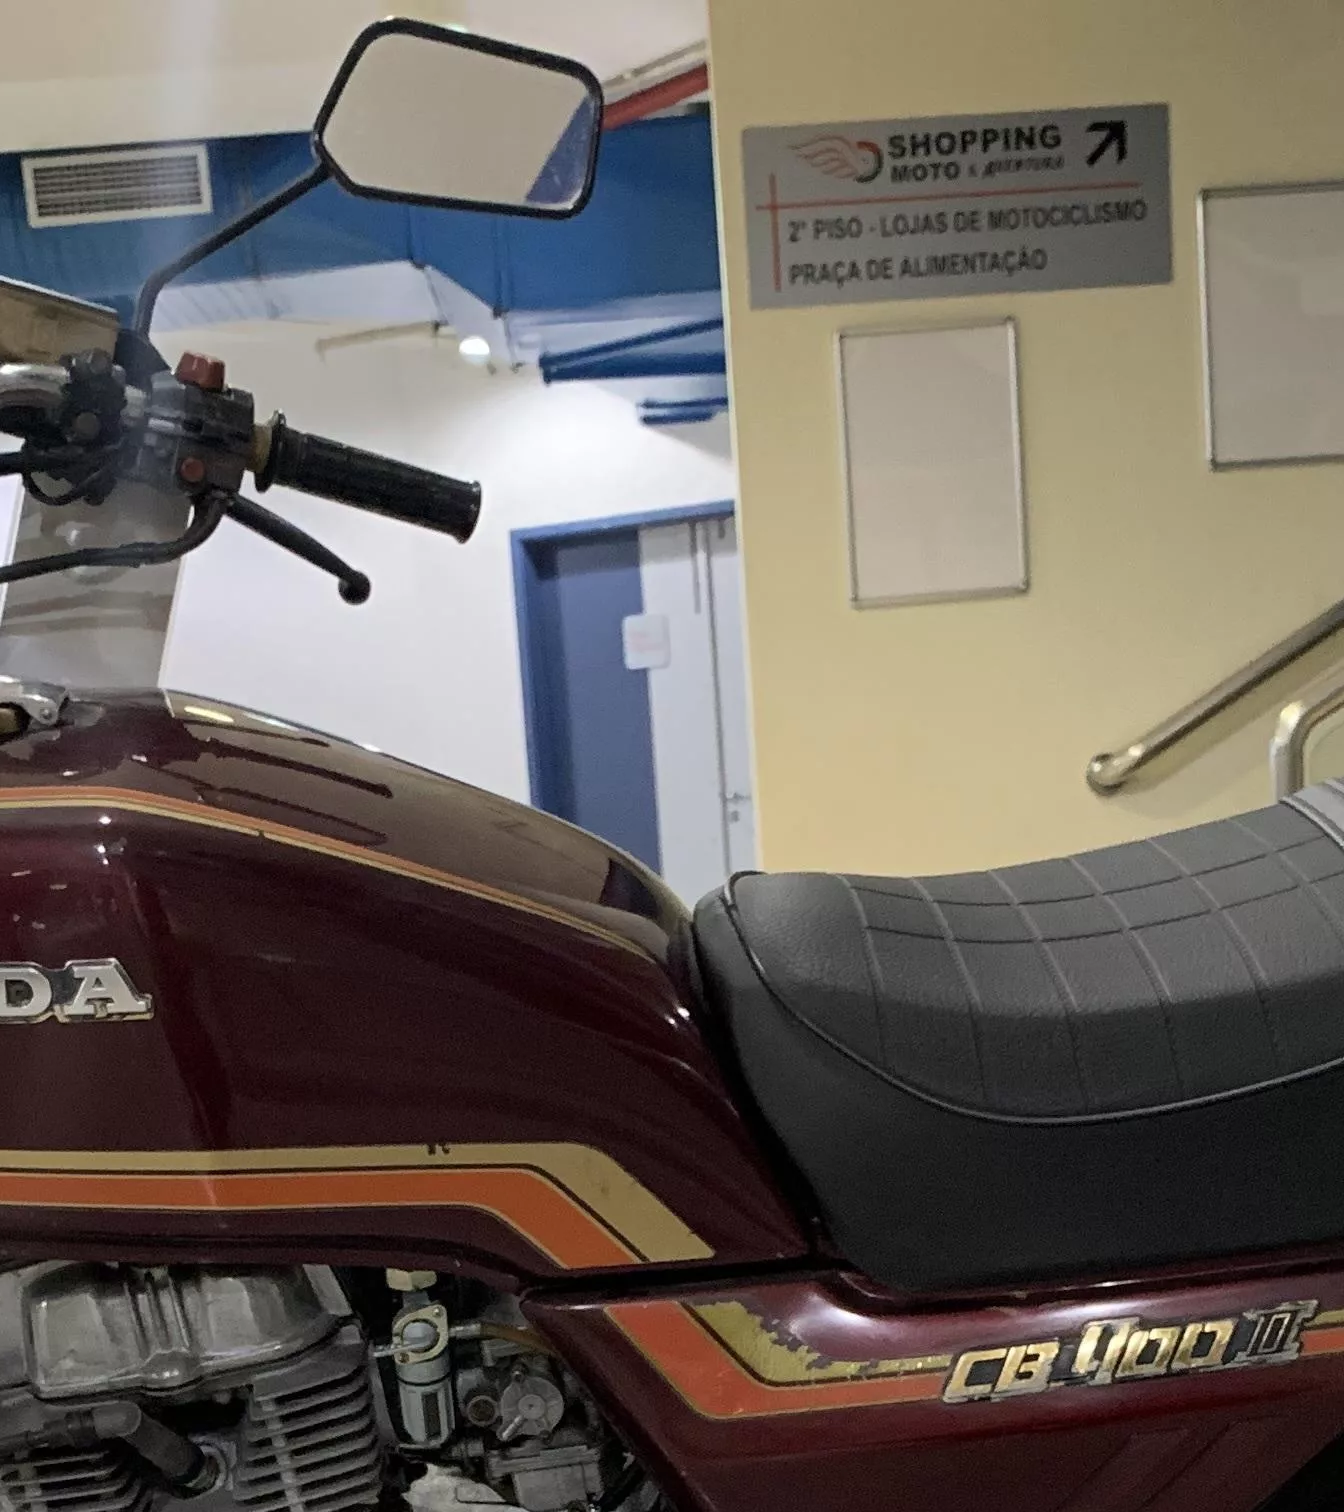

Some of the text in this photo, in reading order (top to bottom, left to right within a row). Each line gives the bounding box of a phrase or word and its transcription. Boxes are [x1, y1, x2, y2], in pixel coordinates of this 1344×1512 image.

[888, 124, 1062, 159] SHOPPING
[891, 161, 961, 183] MOTO
[813, 216, 863, 240] PISO
[880, 211, 948, 238] LOJAS
[954, 210, 982, 233] DE
[988, 198, 1148, 231] MOTOCICLISMO
[789, 246, 1048, 289] PRAÇA DE ALIMENTAÇÃO
[944, 1338, 1058, 1401] CB
[1073, 1317, 1235, 1386] 400
